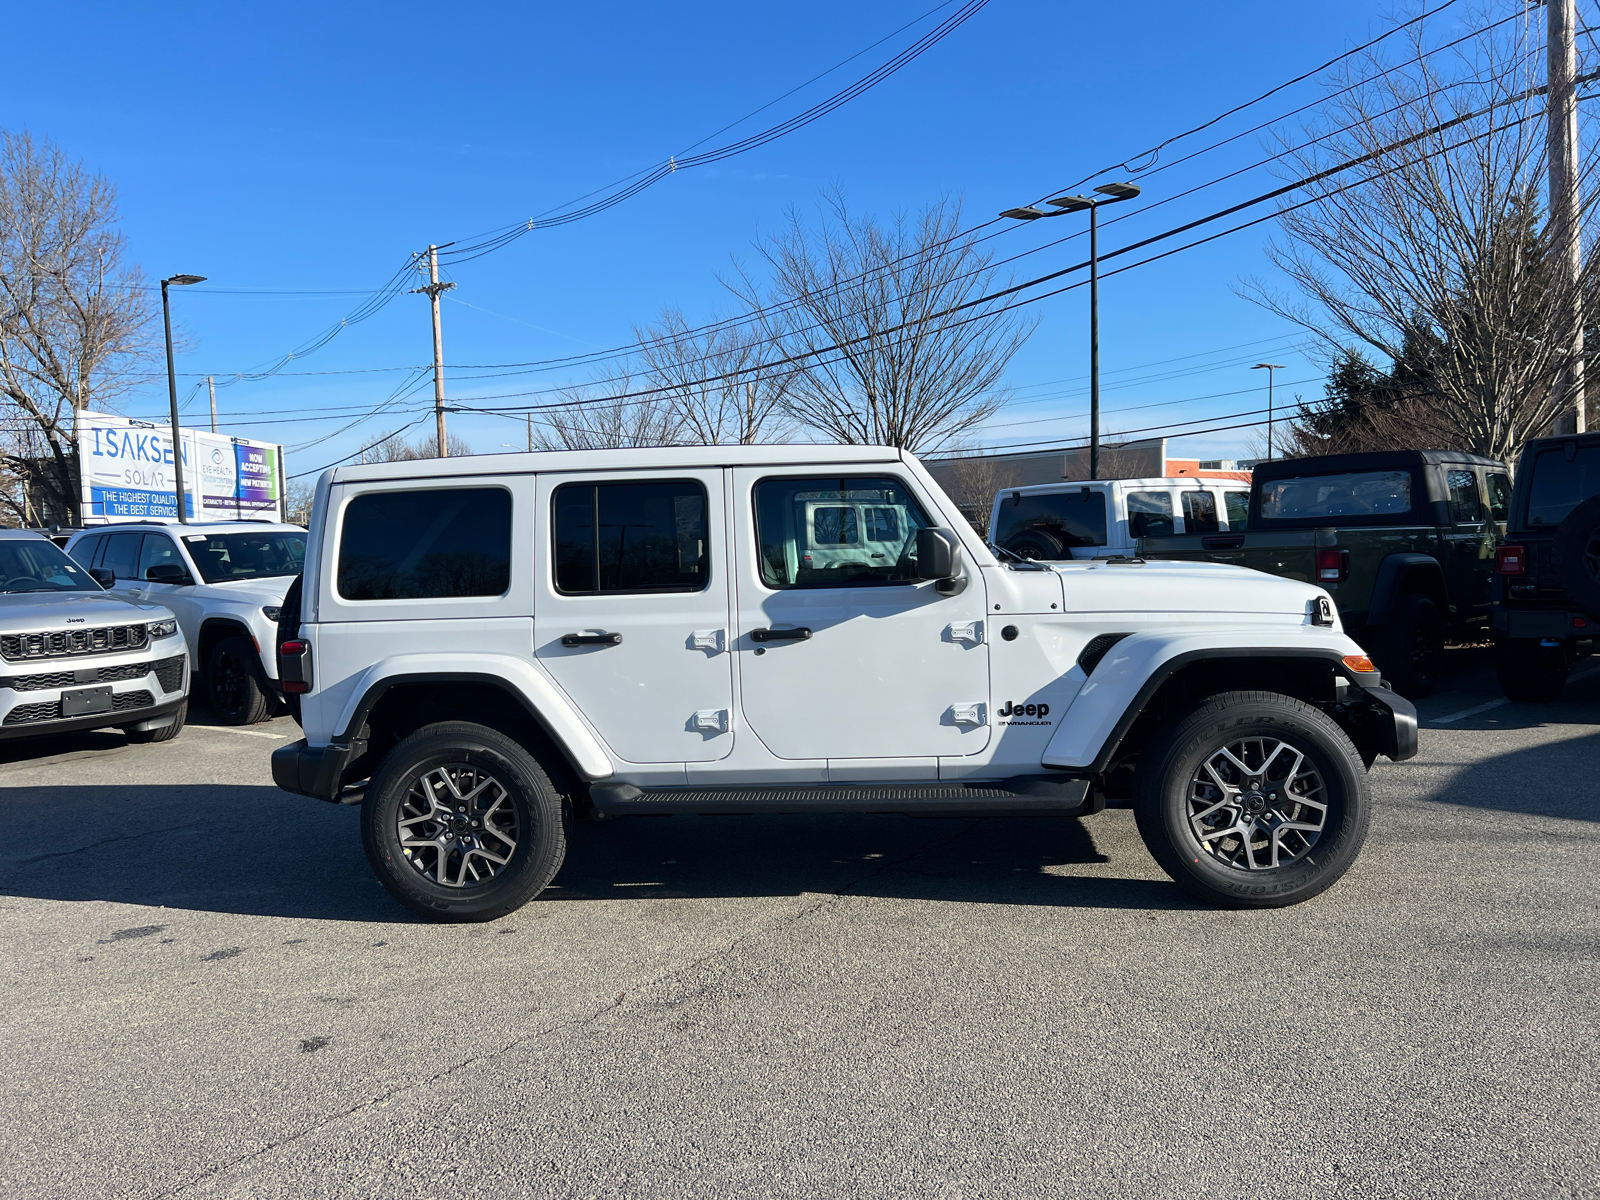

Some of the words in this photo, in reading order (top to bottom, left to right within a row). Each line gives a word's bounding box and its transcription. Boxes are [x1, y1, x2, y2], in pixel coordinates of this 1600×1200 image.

[91, 427, 188, 466] ISAKSEN
[249, 453, 263, 464] NOW
[203, 465, 212, 474] EYE
[213, 466, 233, 476] HEALTH
[241, 462, 272, 475] ACCEPTING
[125, 469, 165, 487] SOLAR
[241, 478, 252, 487] NEW
[252, 479, 273, 489] PATIENTS
[102, 491, 117, 502] THE
[119, 492, 150, 504] HIGHEST
[151, 494, 178, 505] QUALITY
[113, 504, 128, 515] THE
[130, 505, 148, 515] BEST
[149, 505, 177, 517] SERVICE
[997, 701, 1050, 719] Jeep
